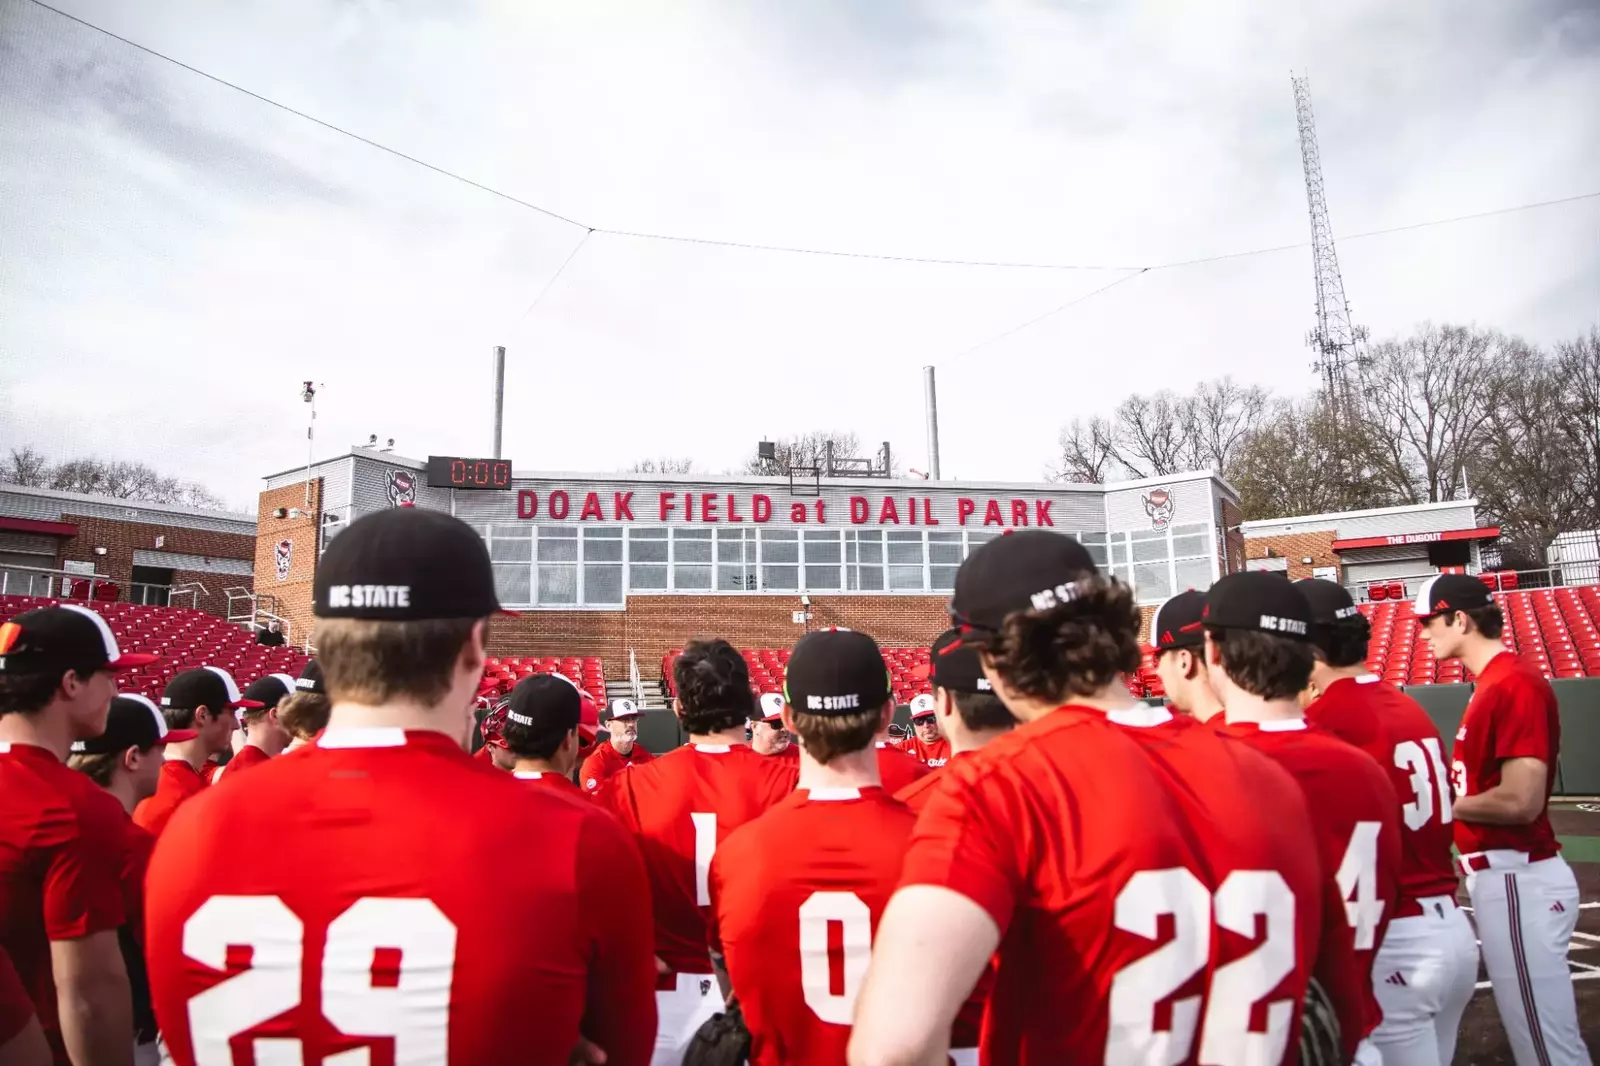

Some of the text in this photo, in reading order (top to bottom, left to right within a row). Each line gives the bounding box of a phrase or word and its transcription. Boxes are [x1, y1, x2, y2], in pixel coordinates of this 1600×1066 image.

[451, 460, 508, 485] 0:00
[517, 490, 1054, 528] DOAK FIELD at DAIL PARK
[1386, 532, 1443, 545] THE DUGOUT
[328, 585, 411, 607] NC STATE
[1030, 589, 1057, 611] NC
[1259, 614, 1307, 635] NC STATE
[513, 712, 533, 726] STATE
[807, 693, 860, 710] NC STATE
[1394, 737, 1452, 832] 31
[1450, 760, 1468, 798] 3
[690, 812, 718, 906] 1
[1334, 821, 1386, 950] 4
[799, 891, 872, 1025] 0
[1106, 868, 1295, 1066] 22
[182, 895, 457, 1066] 29
